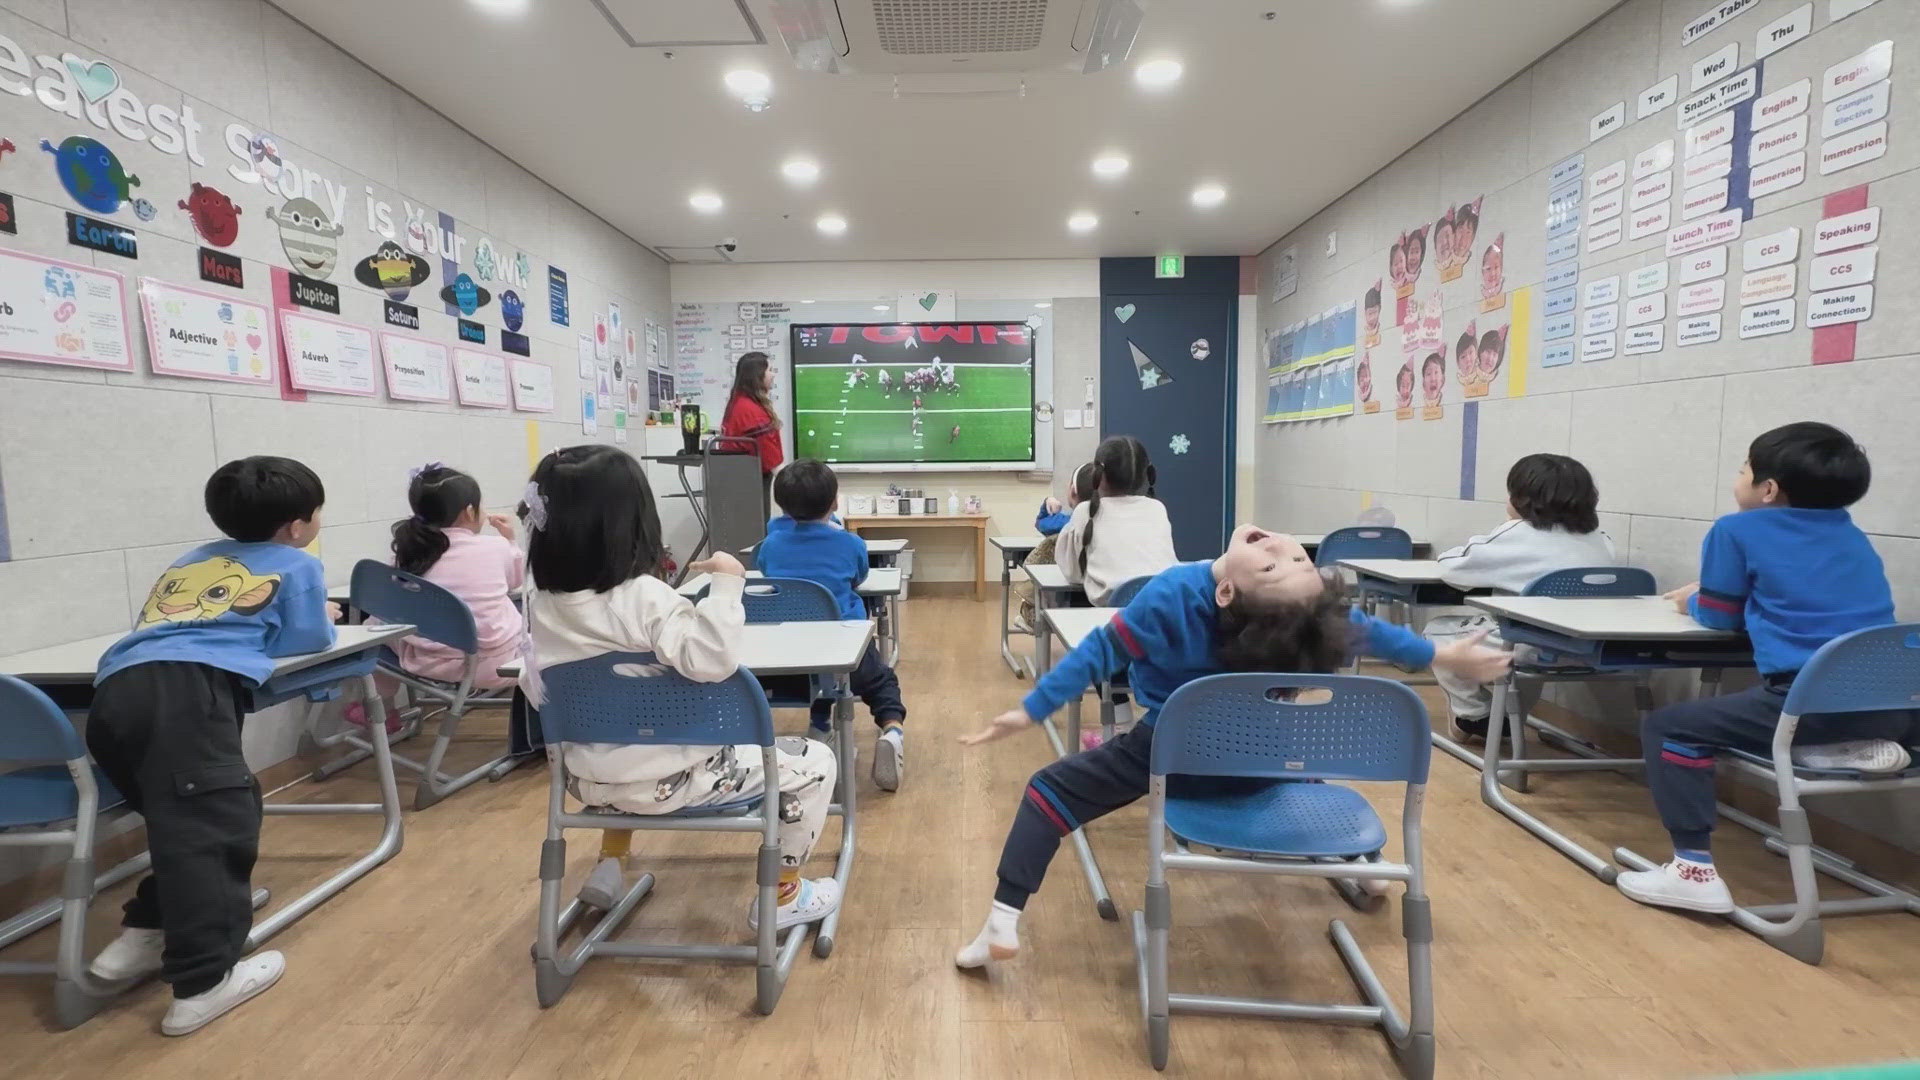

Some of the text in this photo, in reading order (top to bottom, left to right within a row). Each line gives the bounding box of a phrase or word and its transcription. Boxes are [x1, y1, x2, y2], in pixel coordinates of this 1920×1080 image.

[1688, 16, 1716, 37] Time
[1771, 23, 1795, 42] Thu
[1702, 59, 1726, 77] Wed
[1647, 91, 1665, 105] Tue
[1684, 77, 1748, 114] Snack Time
[1835, 93, 1874, 113] Campus
[1761, 95, 1798, 116] English
[1598, 115, 1615, 130] Mon
[1834, 108, 1874, 127] Elective
[1758, 131, 1798, 151] Phonics
[1823, 136, 1883, 162] Immersion
[1596, 171, 1619, 187] English
[1752, 165, 1802, 188] Immersion
[1637, 182, 1666, 198] Phonics
[1684, 191, 1725, 211] Immersion
[364, 185, 396, 238] is
[1636, 213, 1662, 229] English
[1673, 218, 1734, 243] Lunch Time
[1819, 221, 1872, 240] Speaking
[1760, 243, 1780, 257] CCS
[203, 255, 241, 283] Mars
[1694, 260, 1712, 271] CCS
[1829, 263, 1852, 276] CCS
[295, 282, 336, 307] Jupiter
[1822, 295, 1856, 306] Making
[388, 306, 419, 327] Saturn
[1753, 308, 1780, 319] Making
[1811, 305, 1867, 320] Connections
[1742, 317, 1790, 332] Connections
[169, 327, 218, 346] Adjective
[1680, 329, 1718, 341] Connections
[302, 350, 329, 363] Adverb
